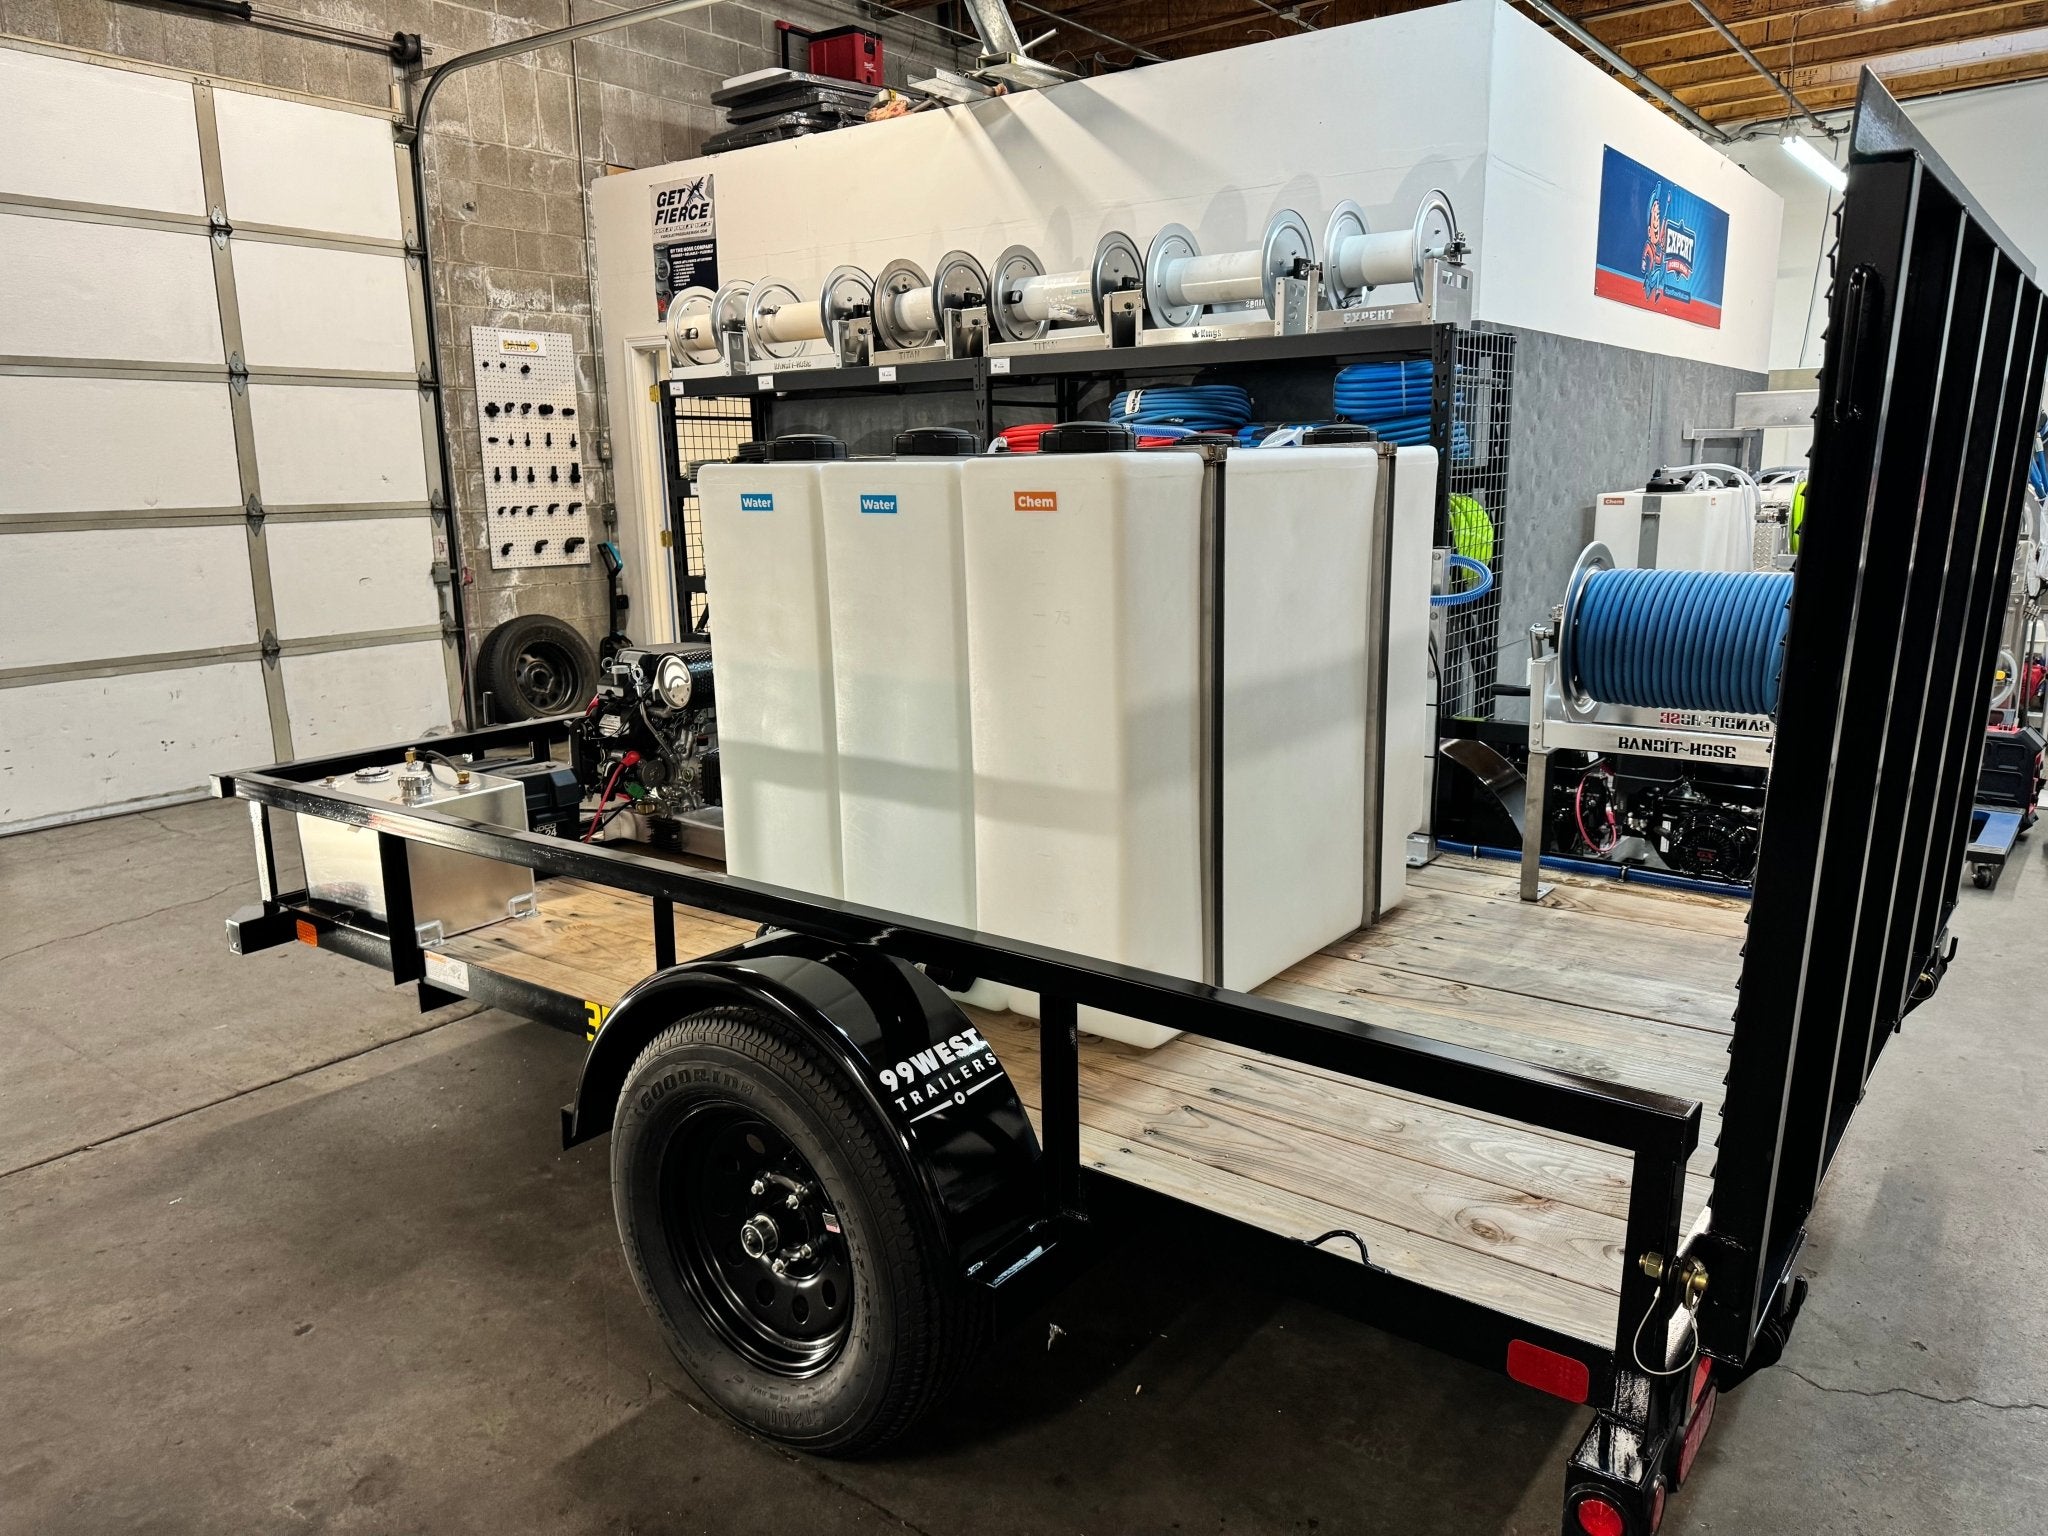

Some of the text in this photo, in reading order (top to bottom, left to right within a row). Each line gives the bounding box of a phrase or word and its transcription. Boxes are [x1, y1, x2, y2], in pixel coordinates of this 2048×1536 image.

[656, 188, 686, 208] GET
[655, 202, 710, 225] FIERCE
[1666, 228, 1694, 263] EXPERT
[1343, 309, 1394, 324] EXPERT
[742, 497, 772, 508] Water
[862, 499, 895, 510] Water
[1018, 496, 1054, 508] Chem
[545, 828, 557, 837] 24
[879, 1027, 983, 1093] 99WEST
[894, 1052, 997, 1112] TRAILERS
